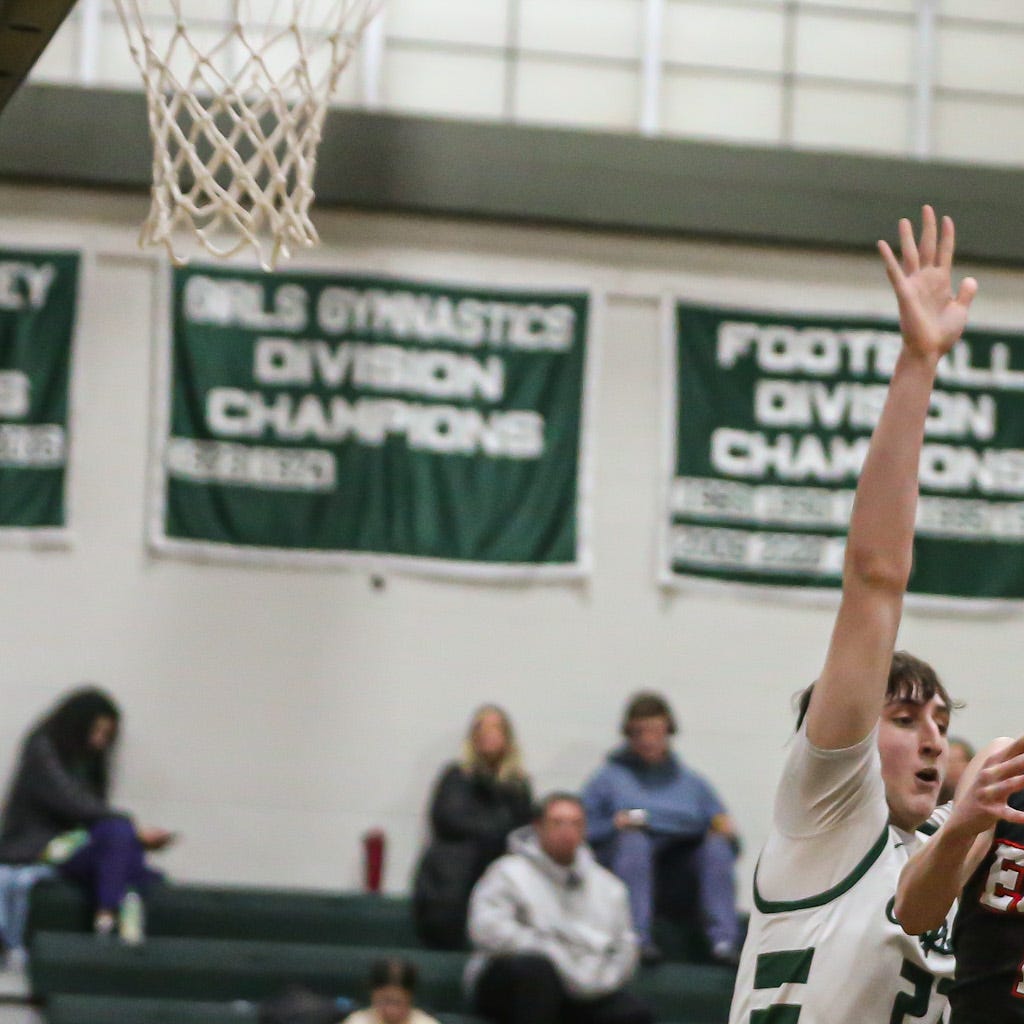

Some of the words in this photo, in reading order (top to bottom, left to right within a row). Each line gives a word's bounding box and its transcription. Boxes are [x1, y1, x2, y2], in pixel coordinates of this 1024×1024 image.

[184, 275, 307, 331] GIRLS
[316, 286, 576, 350] GYMNASTICS
[254, 337, 505, 399] DIVISION
[205, 387, 545, 458] CHAMPIONS
[754, 379, 996, 440] DIVISON
